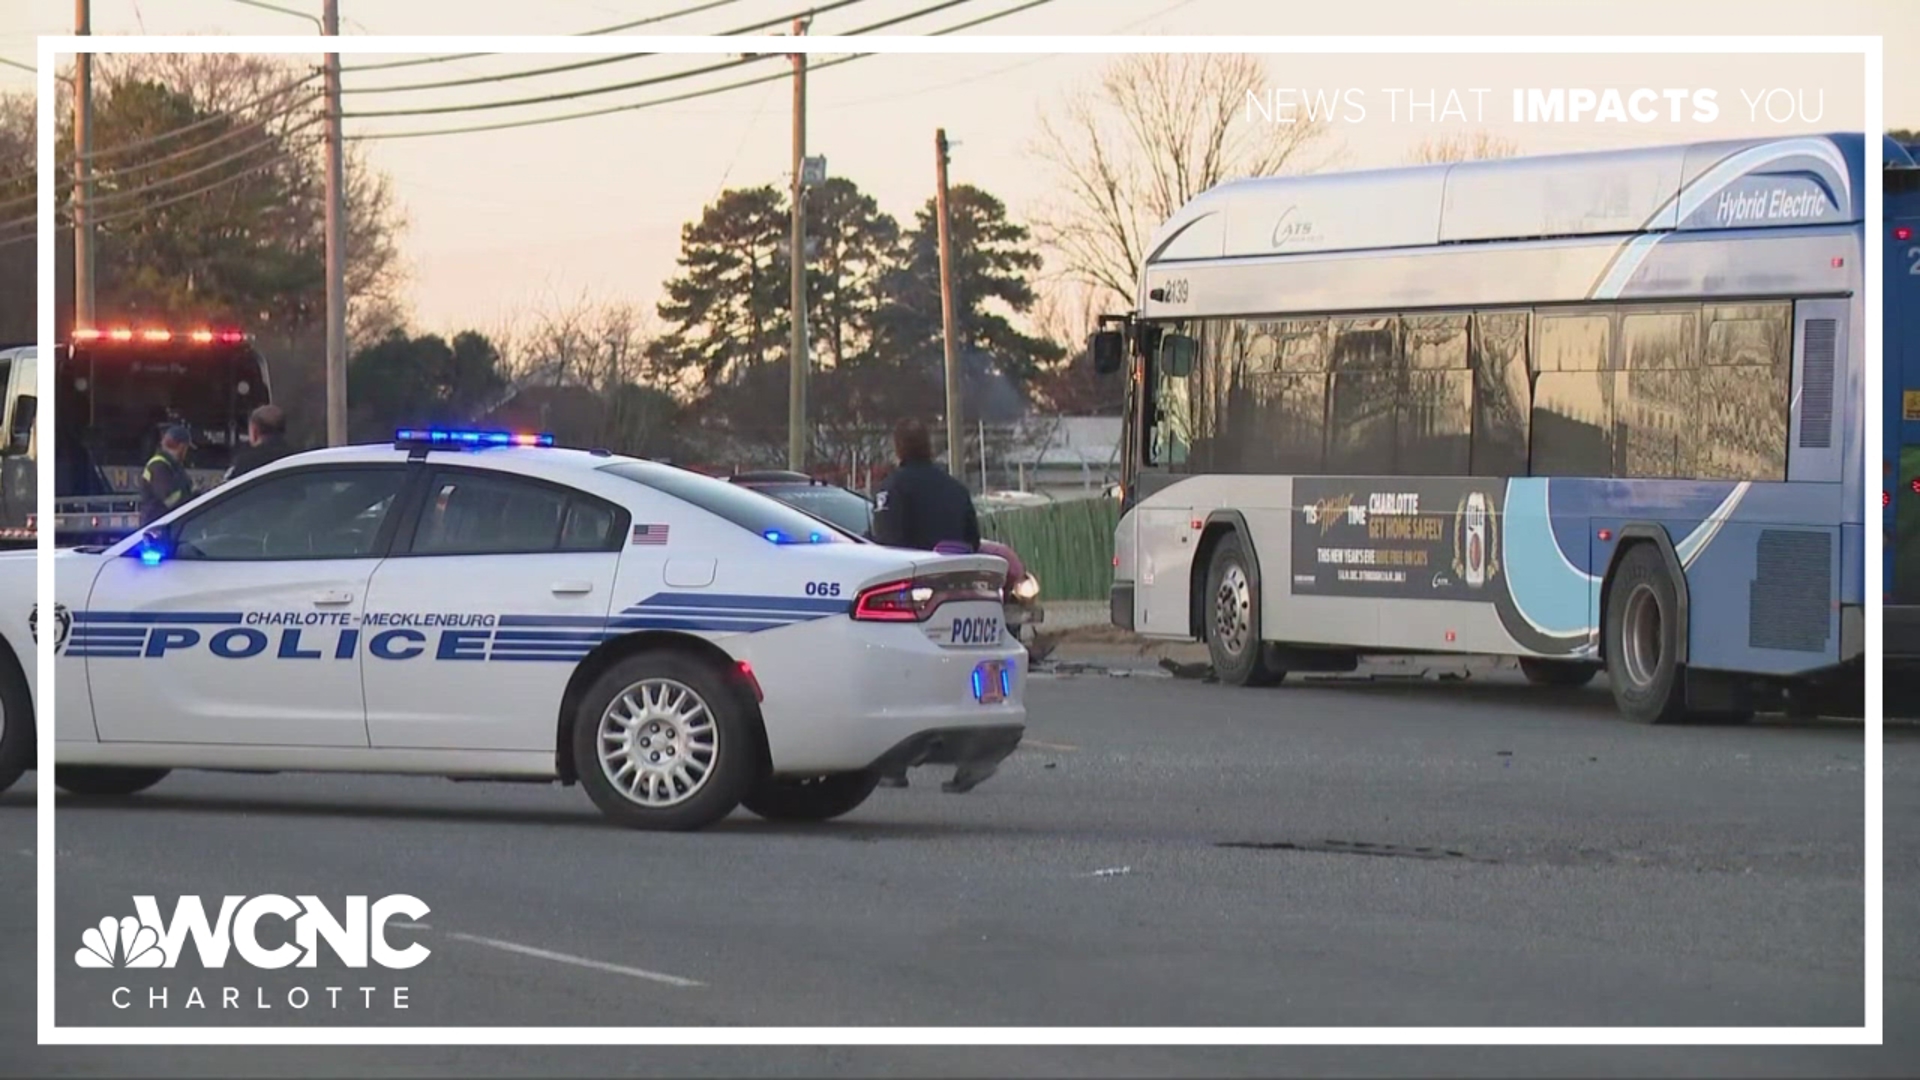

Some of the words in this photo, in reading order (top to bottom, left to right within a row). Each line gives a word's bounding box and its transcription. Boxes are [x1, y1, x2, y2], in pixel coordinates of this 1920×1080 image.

[1716, 191, 1768, 227] Hybrid
[1768, 187, 1825, 219] Electric
[1164, 278, 1189, 304] 2139
[1368, 492, 1420, 516] CHARLOTTE
[1368, 516, 1386, 539] GET
[1386, 516, 1412, 540] HOME
[1412, 516, 1444, 541] SAFELY
[805, 581, 841, 597] 065
[951, 616, 997, 644] POLICE
[144, 627, 492, 661] POLICE
